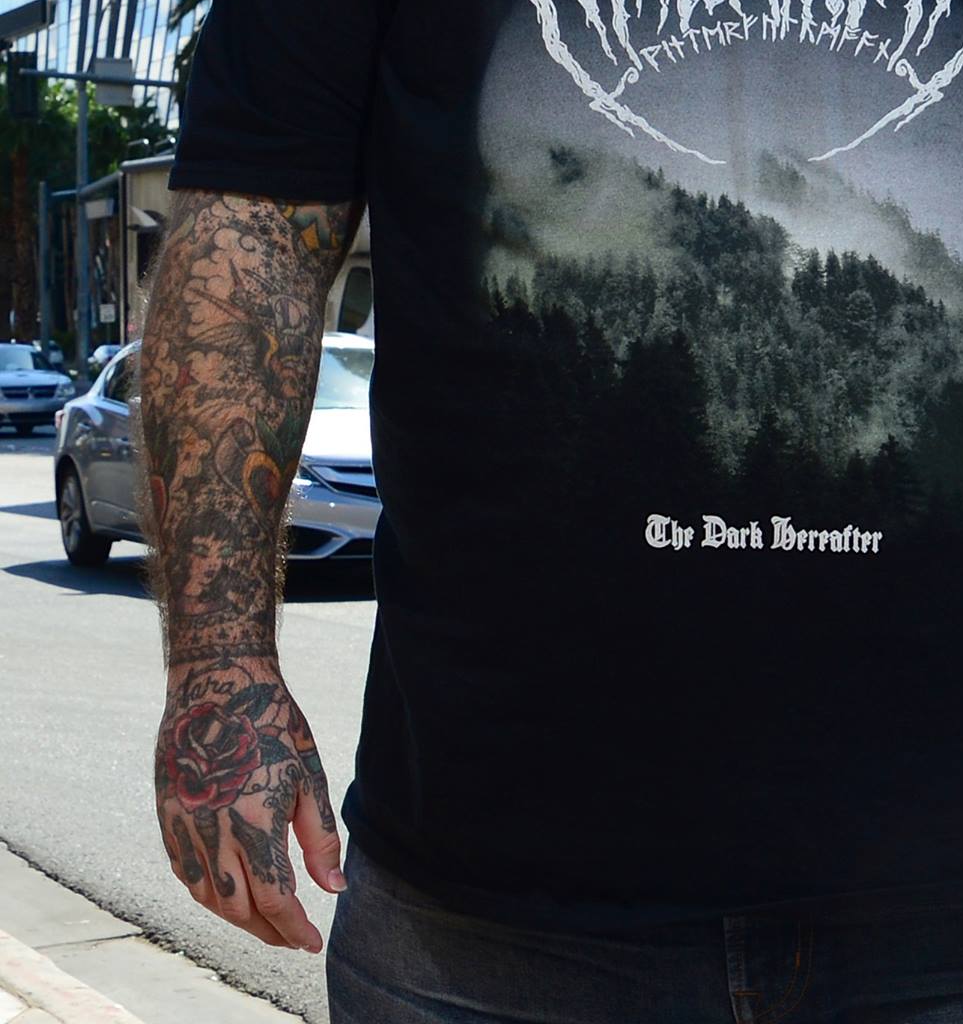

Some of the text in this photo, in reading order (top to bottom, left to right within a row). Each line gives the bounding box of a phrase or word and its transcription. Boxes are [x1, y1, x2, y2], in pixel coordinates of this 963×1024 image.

[644, 514, 883, 554] The Dark Hereafter
